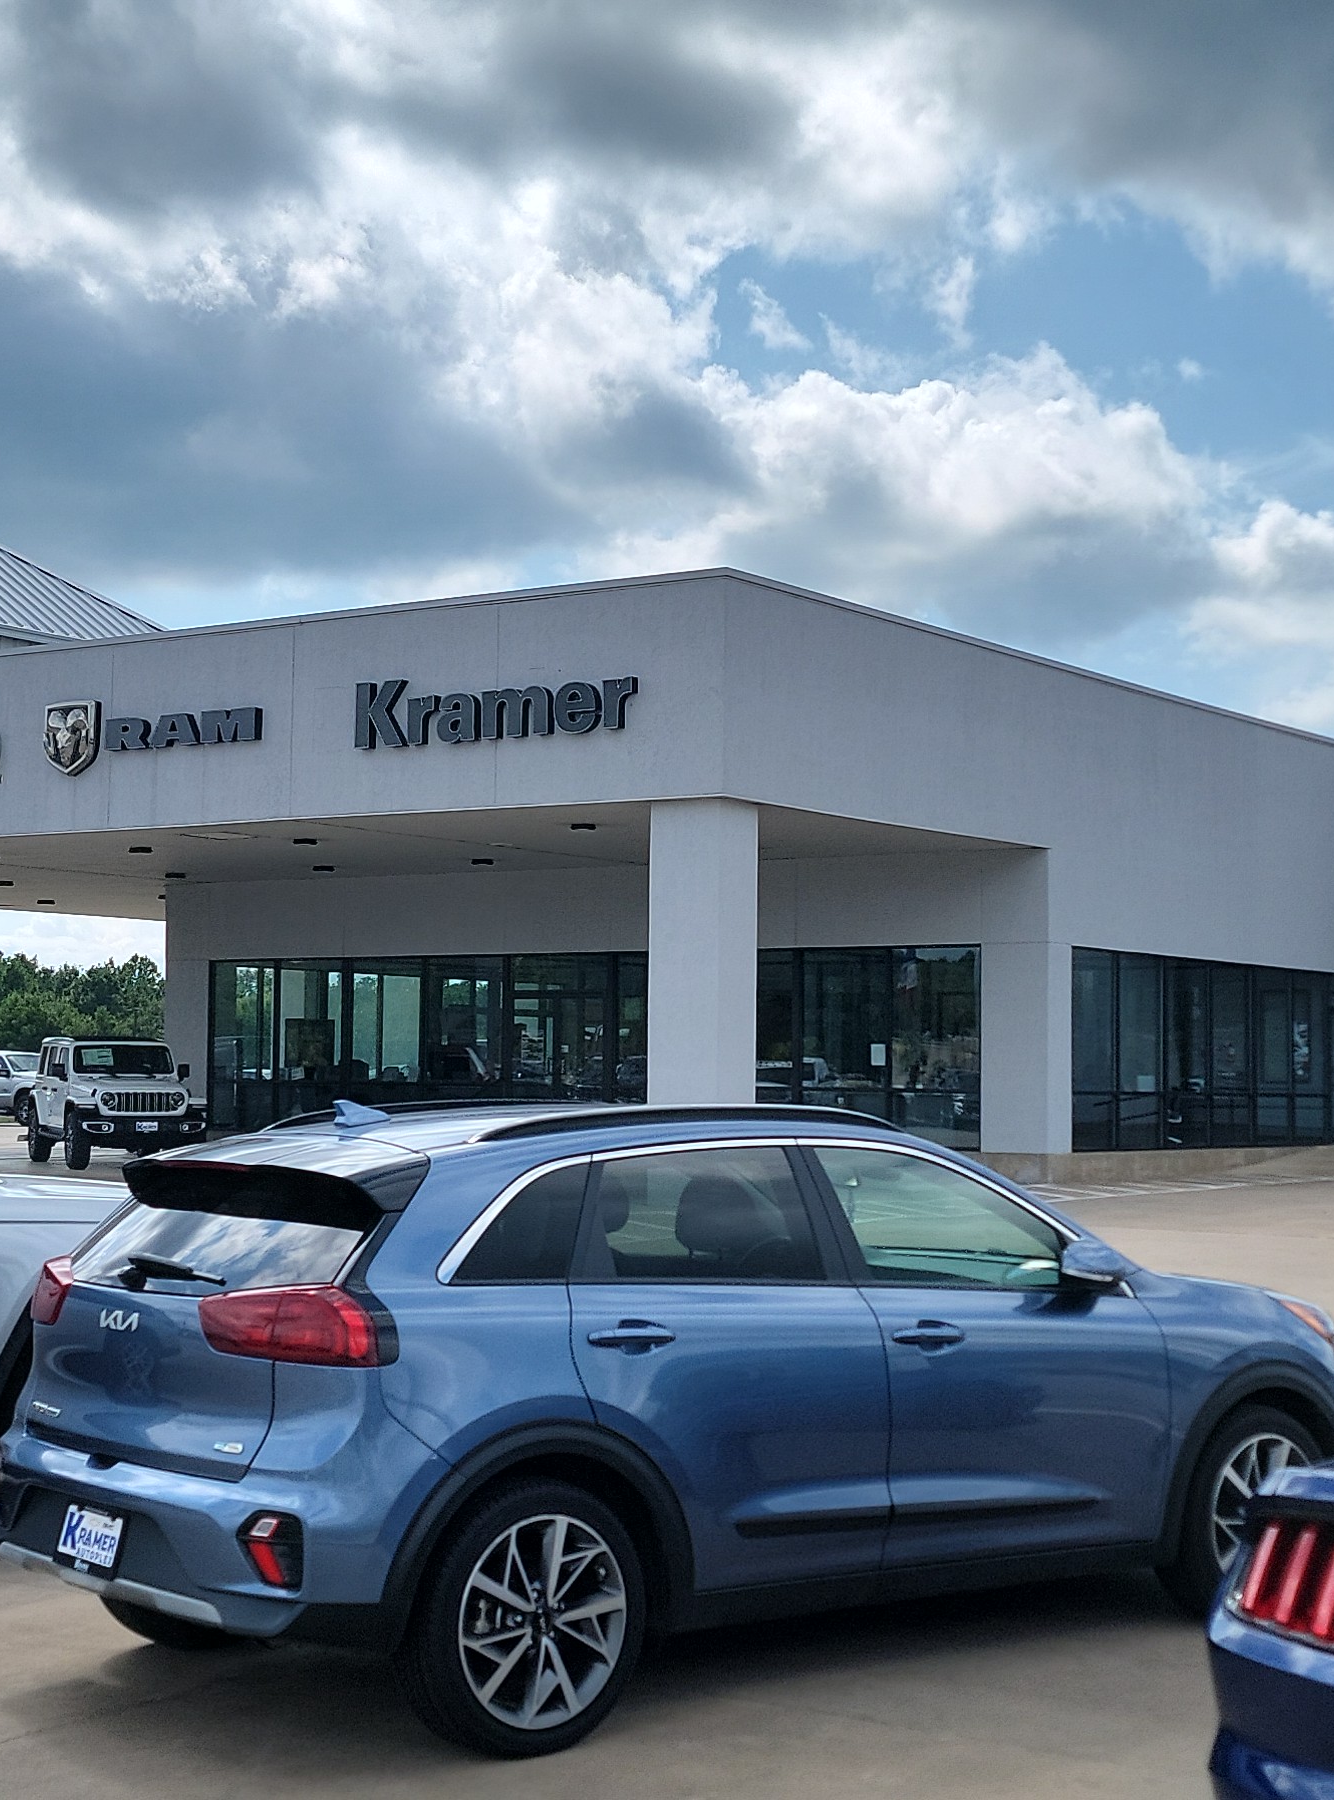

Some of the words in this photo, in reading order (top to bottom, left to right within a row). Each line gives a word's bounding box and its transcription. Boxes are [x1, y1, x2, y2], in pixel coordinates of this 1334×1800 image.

[103, 706, 264, 751] RAM
[354, 675, 639, 752] Kramer
[62, 1511, 117, 1555] KRAMER
